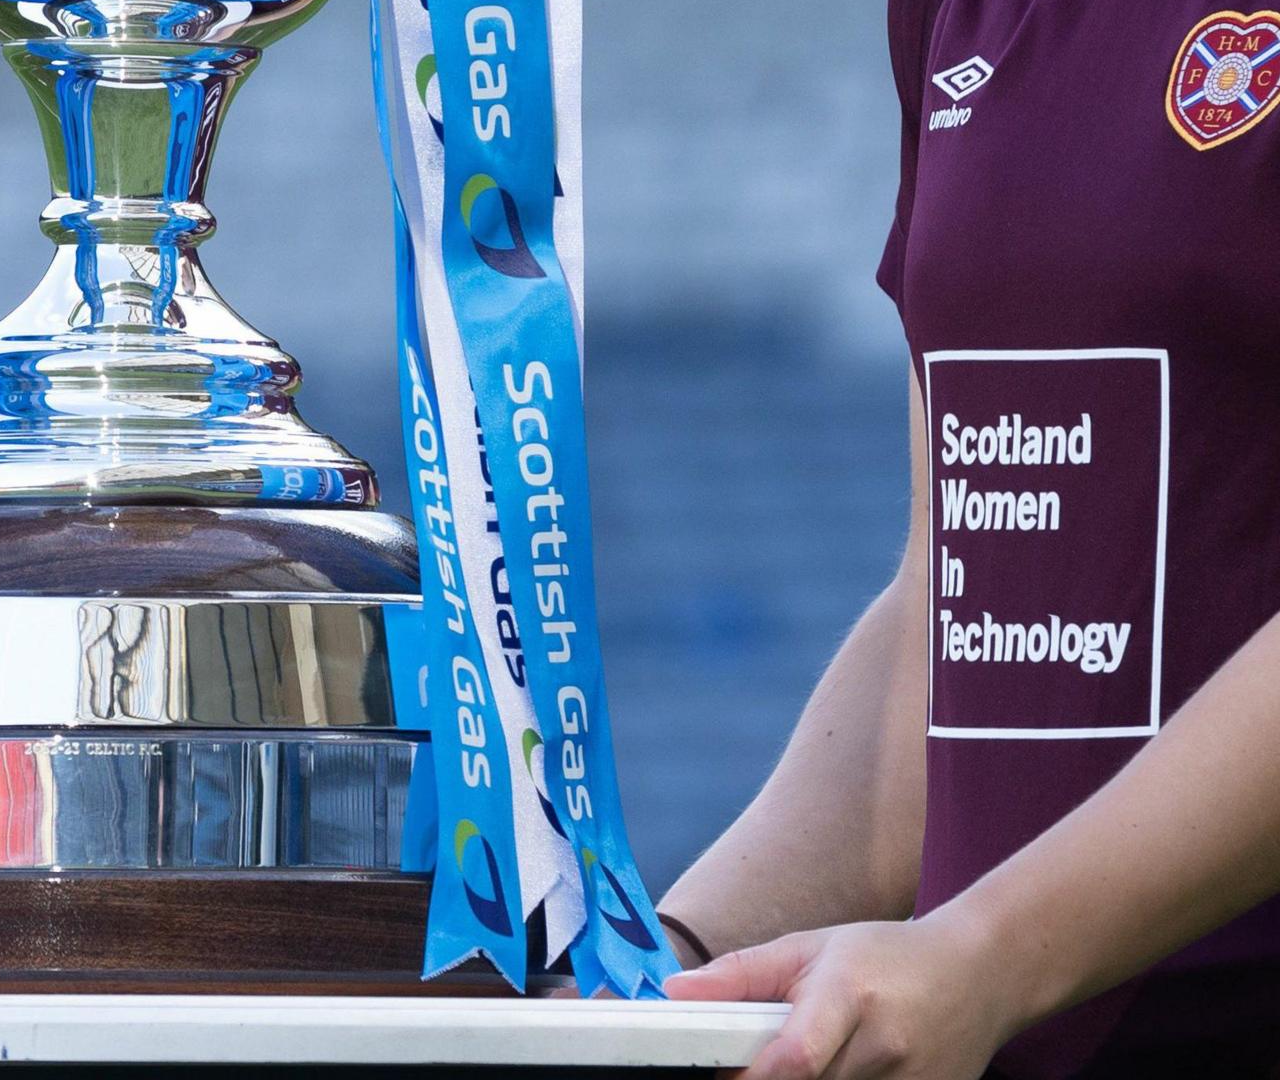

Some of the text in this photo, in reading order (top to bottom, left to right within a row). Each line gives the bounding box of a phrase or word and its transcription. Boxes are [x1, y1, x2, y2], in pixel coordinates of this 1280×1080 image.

[464, 5, 517, 142] Gas
[1188, 68, 1272, 86] F C
[928, 103, 972, 131] umbro
[1197, 109, 1233, 122] 1874
[940, 412, 1092, 465] Scotland
[940, 478, 1061, 531] Women
[403, 339, 491, 789] Scottish Gas
[940, 545, 964, 598] In
[502, 360, 593, 822] Scottish Gas
[939, 608, 1132, 674] Technology
[85, 742, 136, 756] CELTIC
